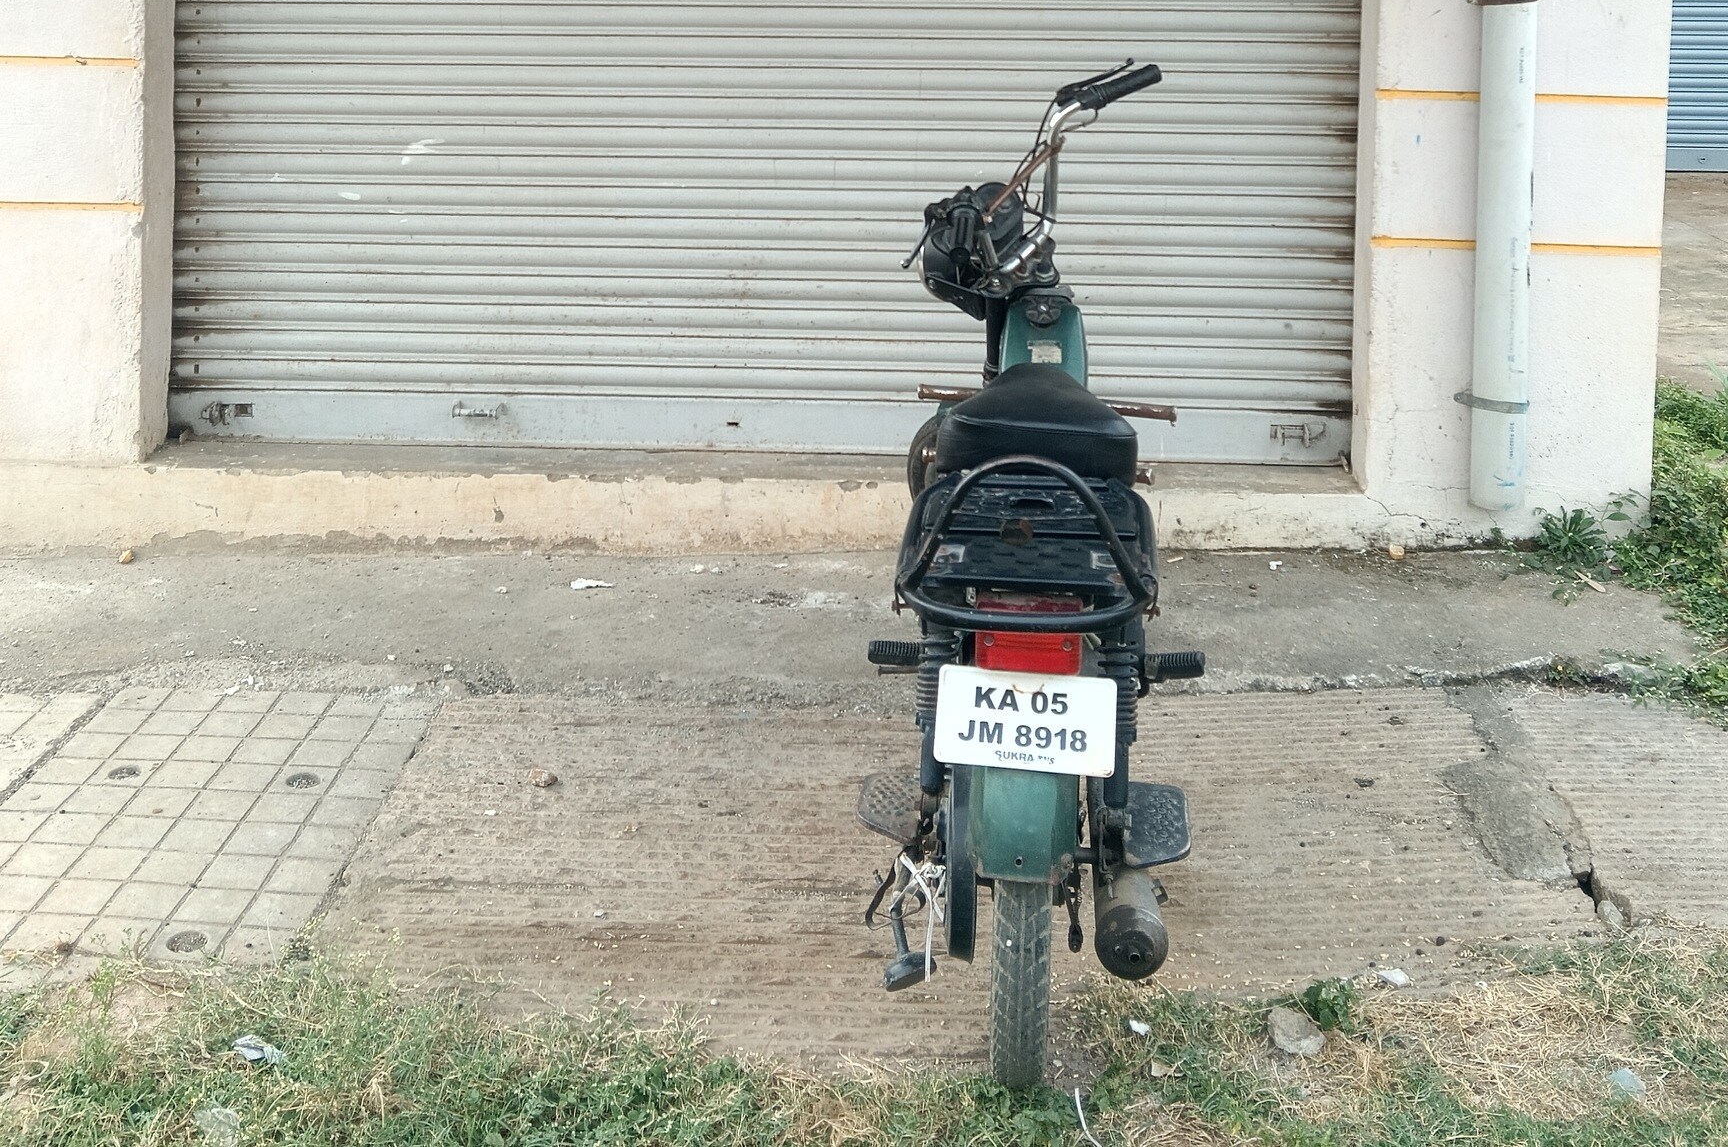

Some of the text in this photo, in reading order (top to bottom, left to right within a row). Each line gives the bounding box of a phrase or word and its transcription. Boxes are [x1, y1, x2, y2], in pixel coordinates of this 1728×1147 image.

[974, 686, 1069, 715] KA 05
[958, 720, 1087, 752] JM 8918
